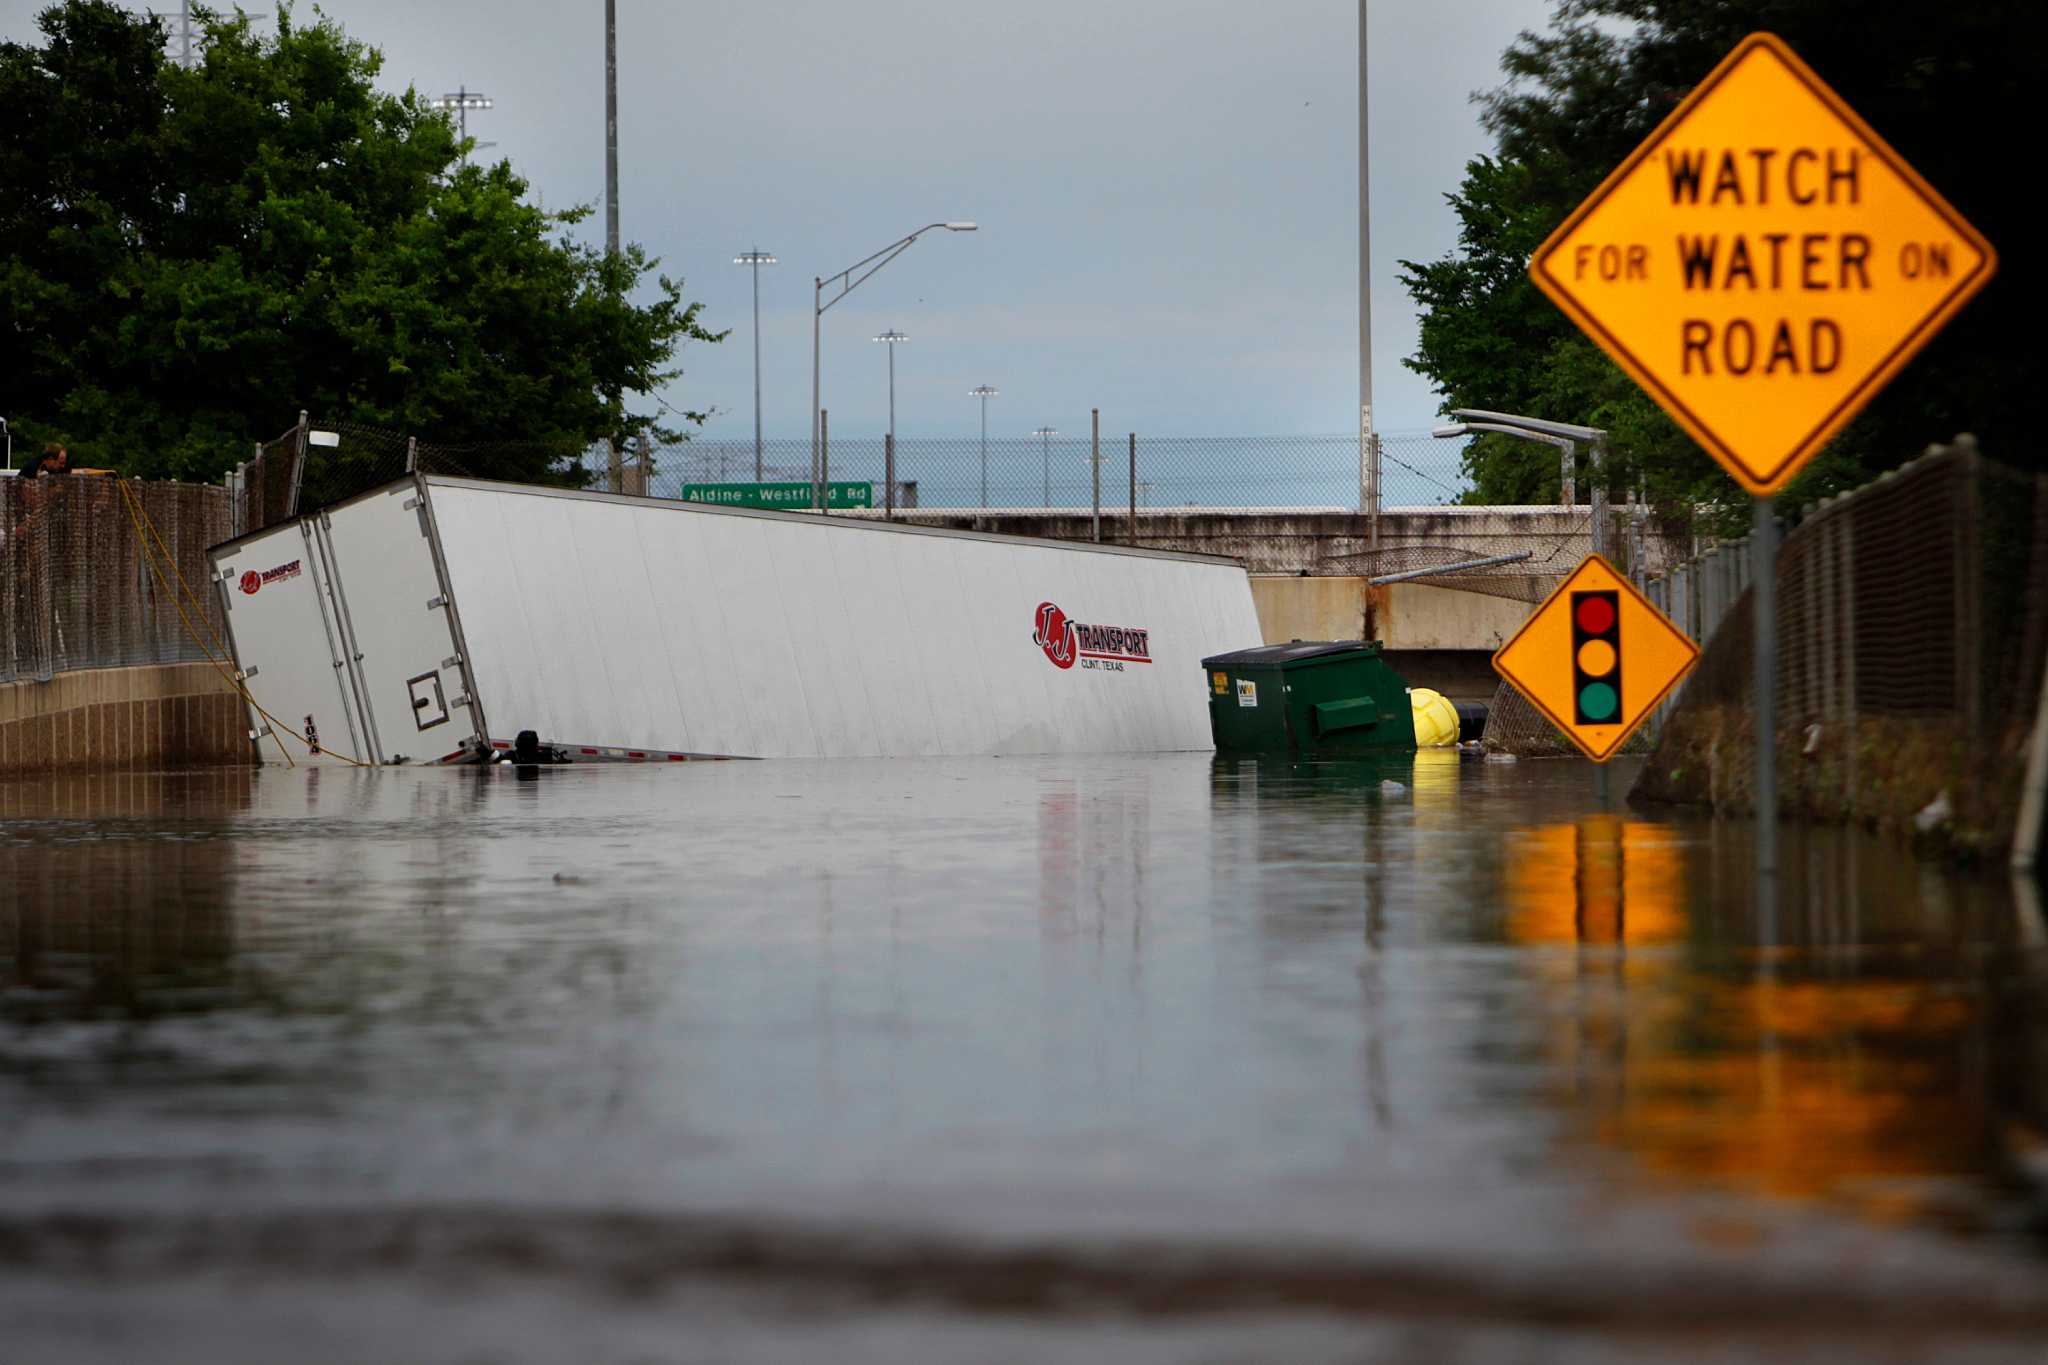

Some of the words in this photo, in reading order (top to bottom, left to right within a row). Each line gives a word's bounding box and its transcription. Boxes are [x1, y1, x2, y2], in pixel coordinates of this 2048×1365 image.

[1665, 149, 1861, 206] WATCH
[1575, 244, 1649, 282] FOR
[1678, 233, 1872, 291] WATER
[1901, 242, 1952, 279] ON
[1682, 318, 1842, 376] ROAD
[690, 489, 742, 501] Aldine
[760, 487, 837, 500] Westfid
[847, 487, 866, 499] Rd
[262, 559, 300, 581] TRANSPORT
[1075, 624, 1149, 657] TRANSPORT
[1102, 660, 1124, 672] TEXAS
